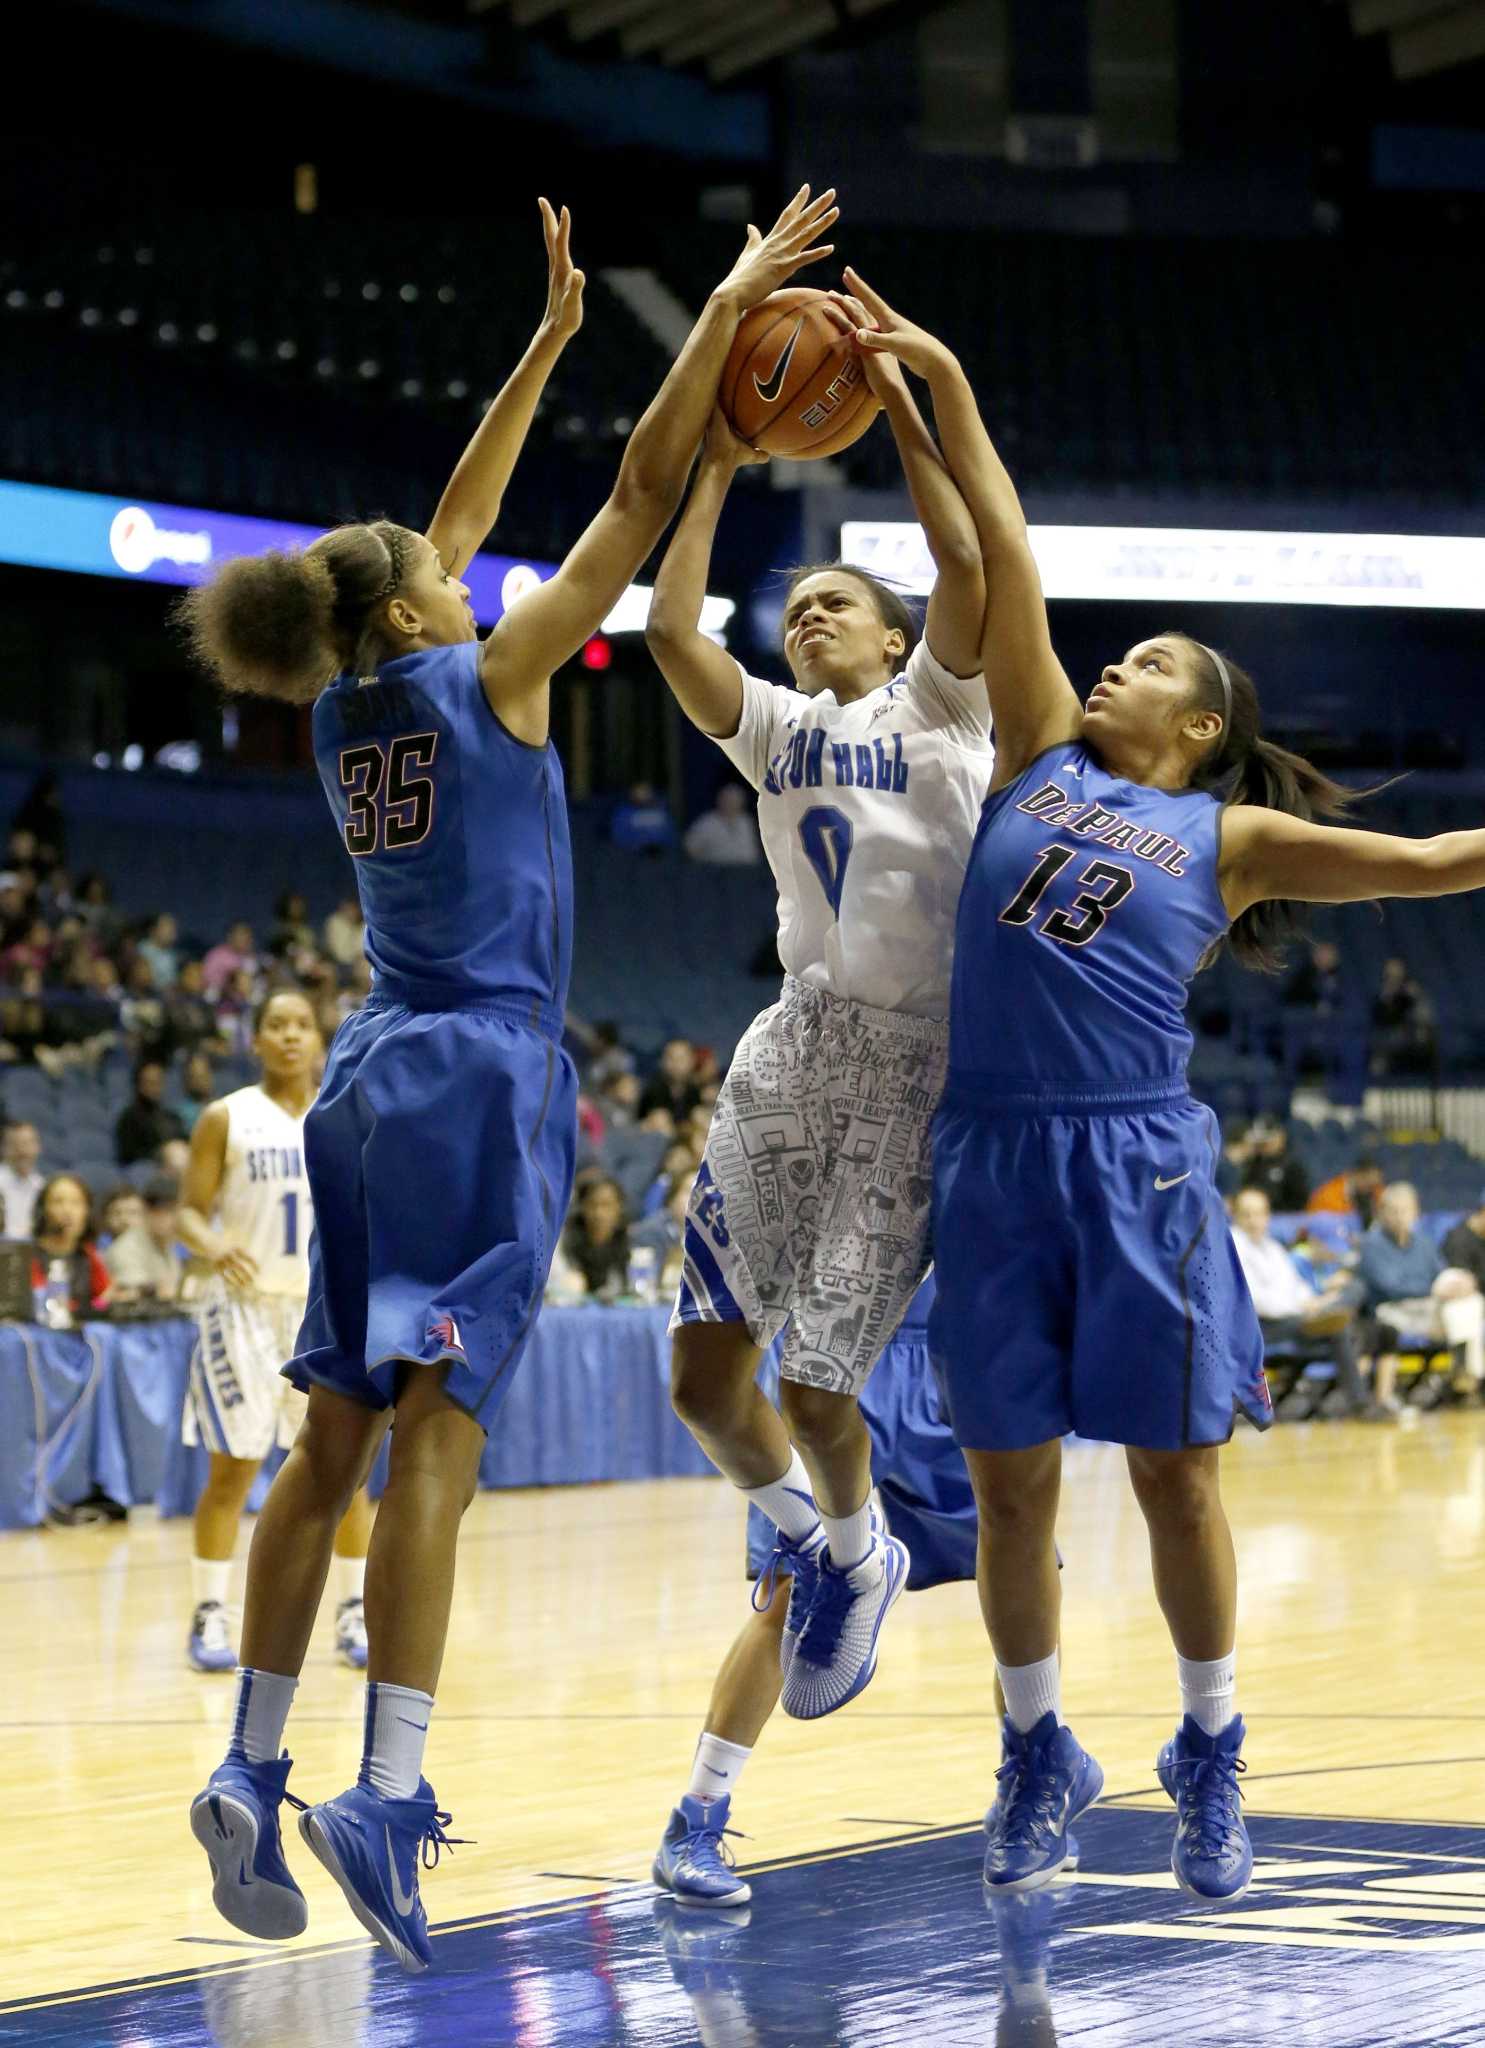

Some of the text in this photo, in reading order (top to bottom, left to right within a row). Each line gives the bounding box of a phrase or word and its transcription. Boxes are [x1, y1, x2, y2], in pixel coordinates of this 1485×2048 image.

[800, 359, 862, 429] ELITE
[340, 732, 439, 856] 35
[832, 732, 909, 795] HALL
[797, 804, 854, 922] 0
[1015, 781, 1190, 878] DEPAUL
[998, 844, 1136, 947] 13
[852, 1273, 895, 1372] HARDWARE
